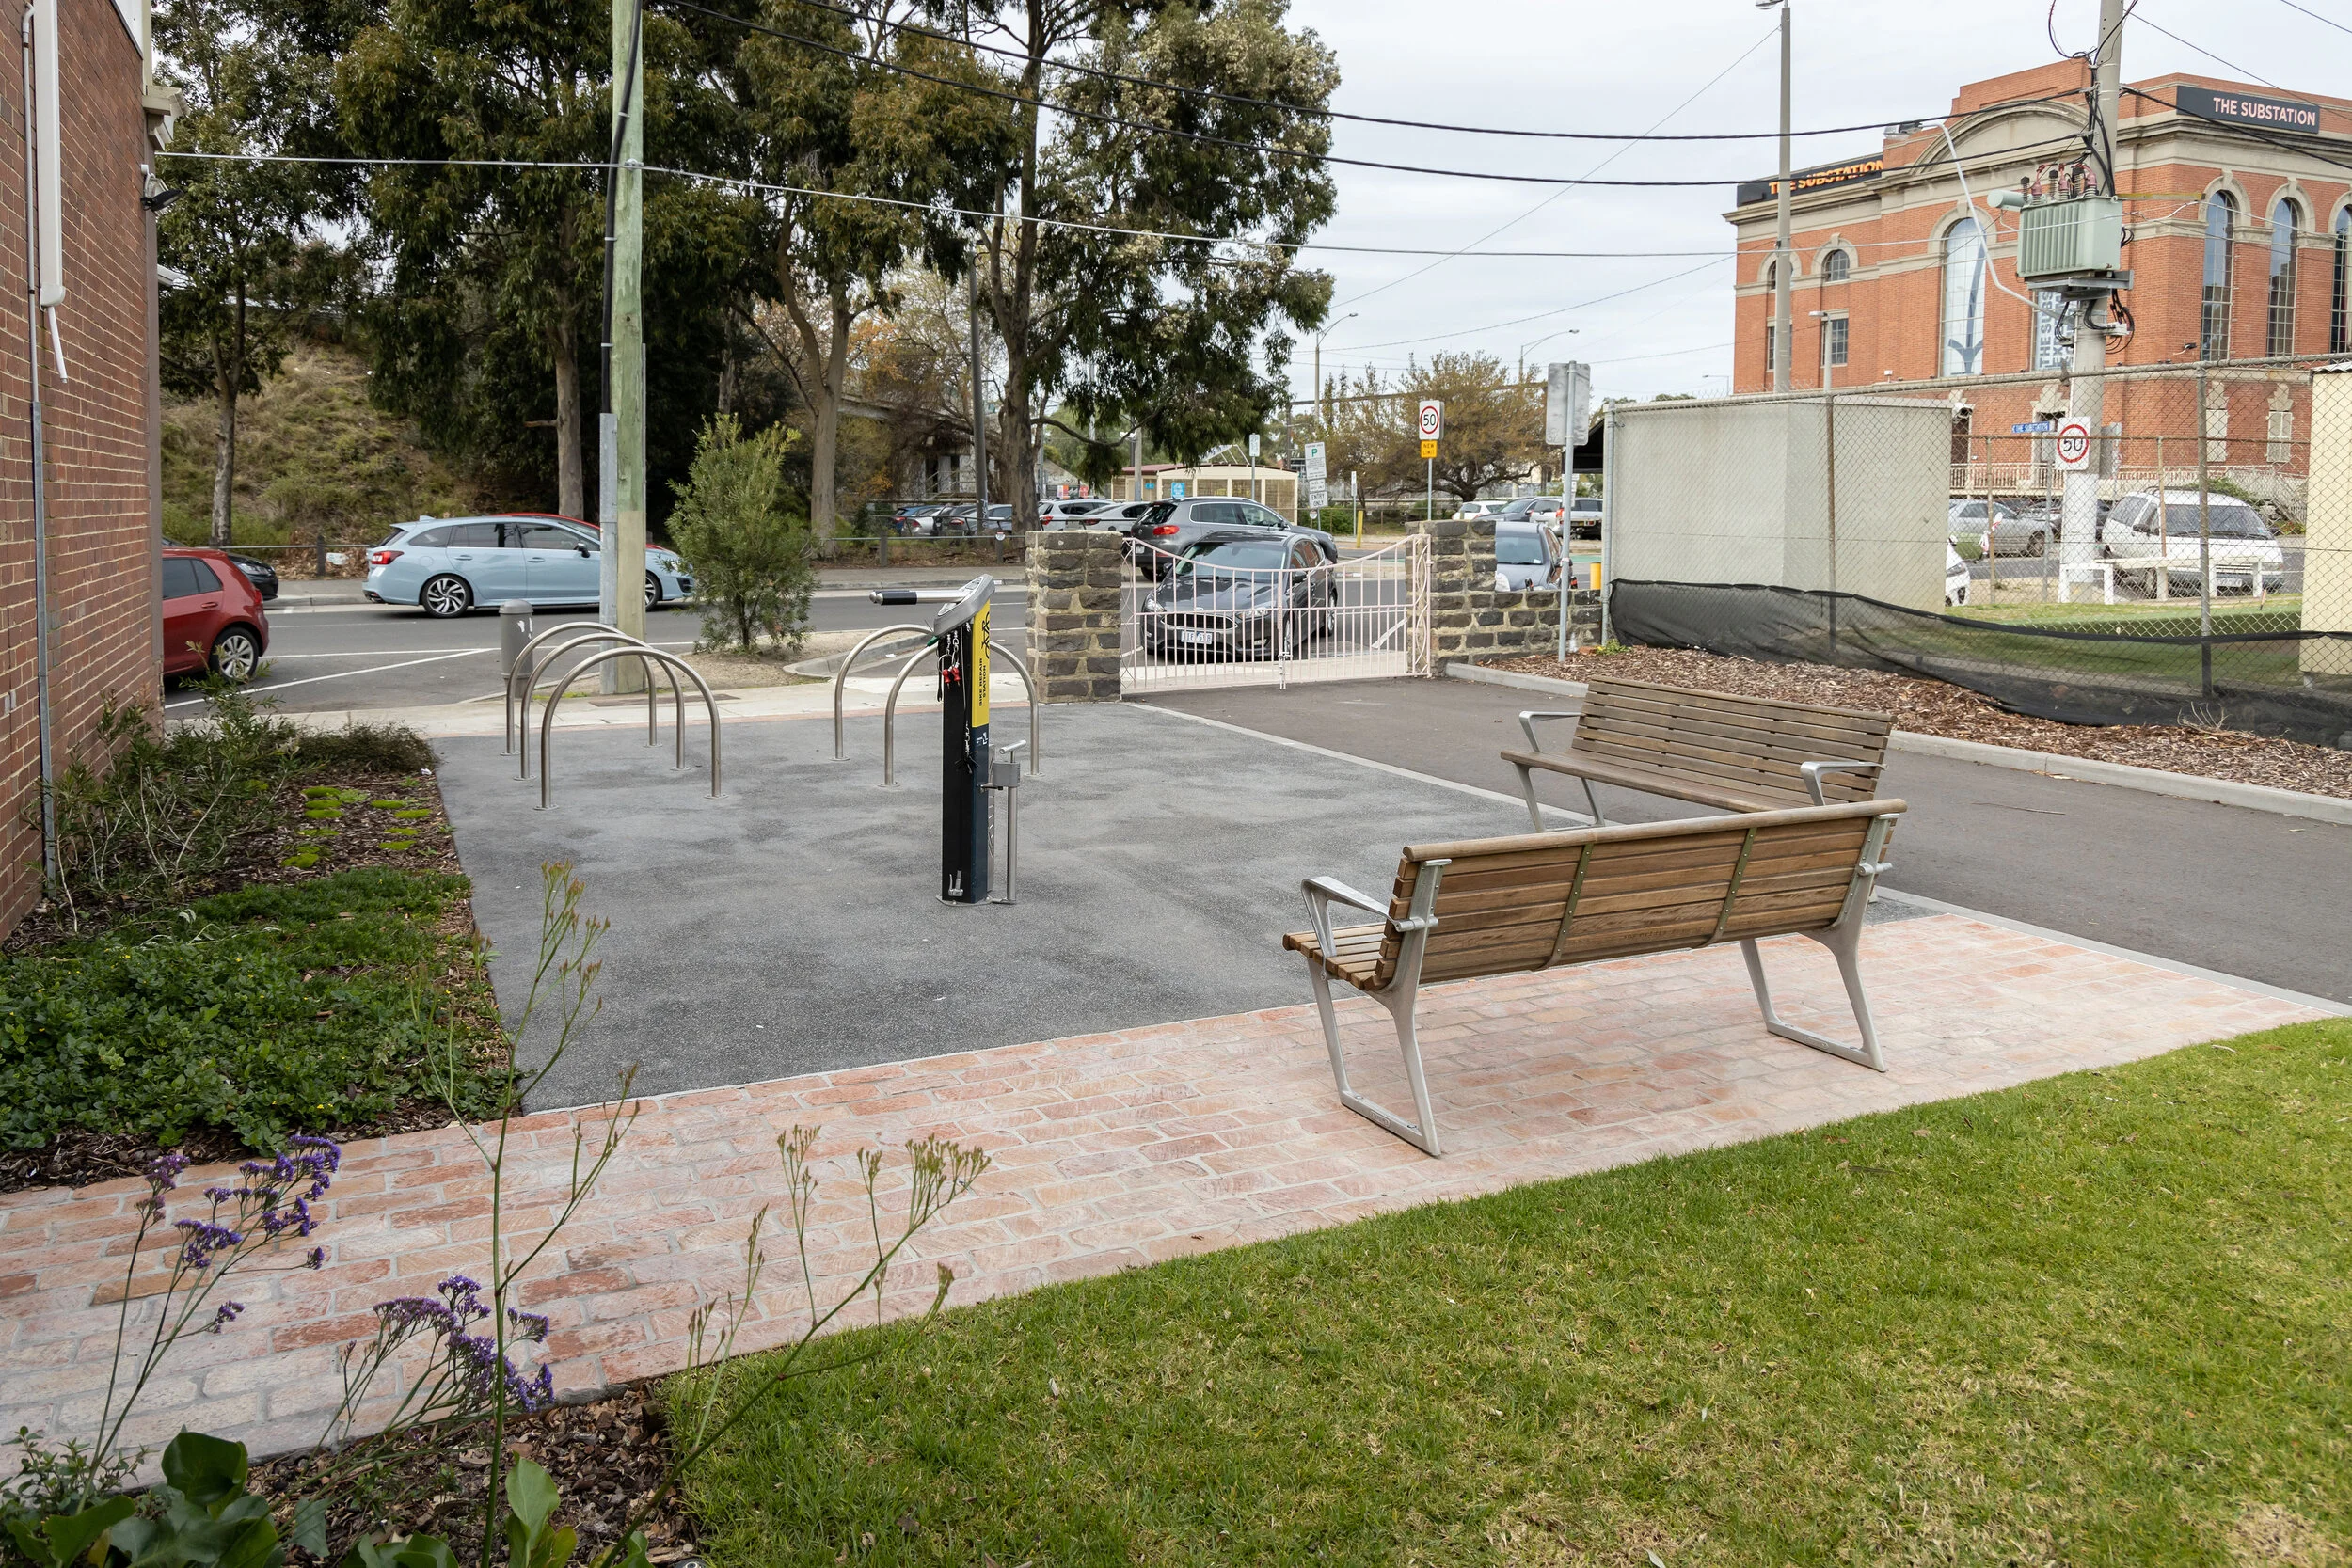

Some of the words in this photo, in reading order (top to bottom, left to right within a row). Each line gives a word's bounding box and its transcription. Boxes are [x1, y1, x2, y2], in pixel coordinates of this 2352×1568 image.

[2213, 97, 2238, 115] THE
[2241, 101, 2316, 126] SUBSTATION
[1423, 414, 1436, 426] 50
[2063, 436, 2084, 452] 50
[1311, 448, 1318, 457] P
